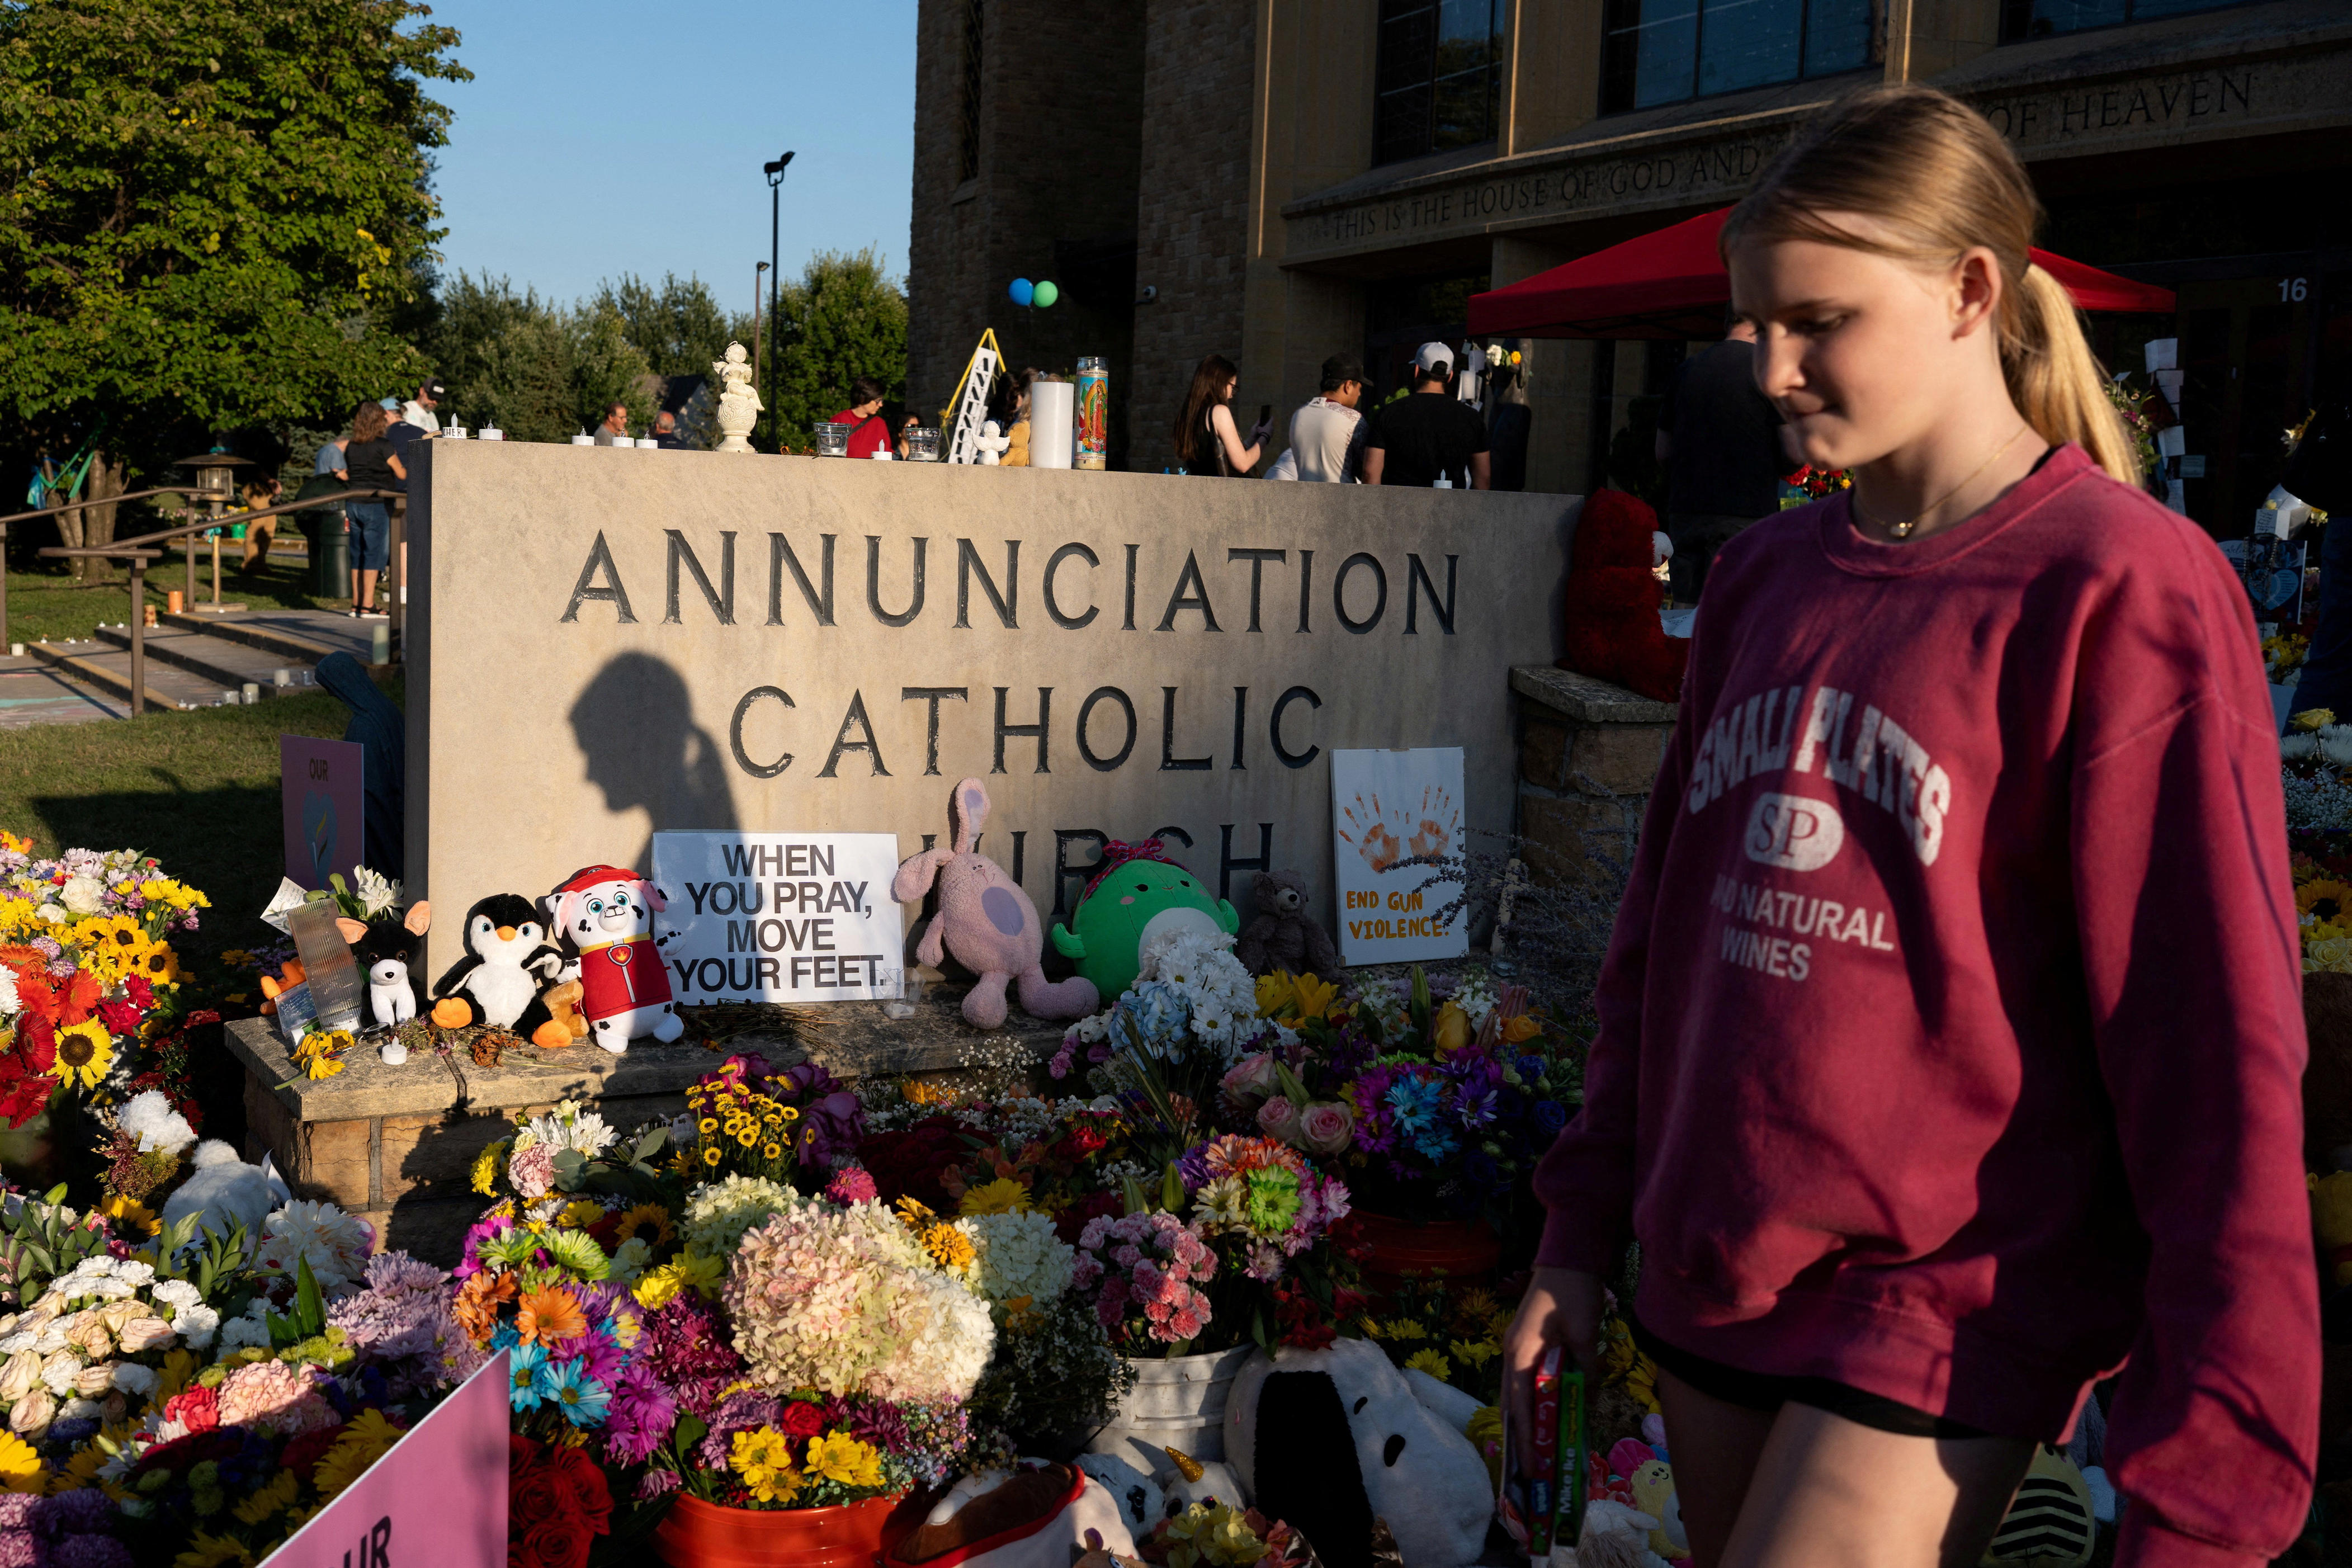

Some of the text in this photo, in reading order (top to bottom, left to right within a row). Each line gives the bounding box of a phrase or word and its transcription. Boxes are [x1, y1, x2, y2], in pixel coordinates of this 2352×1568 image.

[1987, 73, 2254, 138] OF HEAVEN
[1334, 145, 1761, 240] THIS IS THE HOUSE OF GOD AND
[2278, 277, 2307, 303] 16
[556, 528, 1460, 635] ANNUNCIATION
[729, 684, 1323, 778] CATHOLIC
[309, 758, 328, 782] OUR
[1688, 686, 1951, 867] SMALL PLATES
[1754, 803, 1819, 859] SP
[721, 844, 834, 877] WHEN
[685, 881, 872, 919] YOU PRAY,
[1346, 890, 1423, 913] END GUN
[1736, 882, 1895, 951] NATURAL
[727, 918, 835, 952] MOVE
[1348, 916, 1449, 941] VIOLENCE.
[672, 954, 885, 992] YOUR FEET.
[1720, 924, 1812, 983] WINES
[1558, 1472, 1574, 1514] Mike
